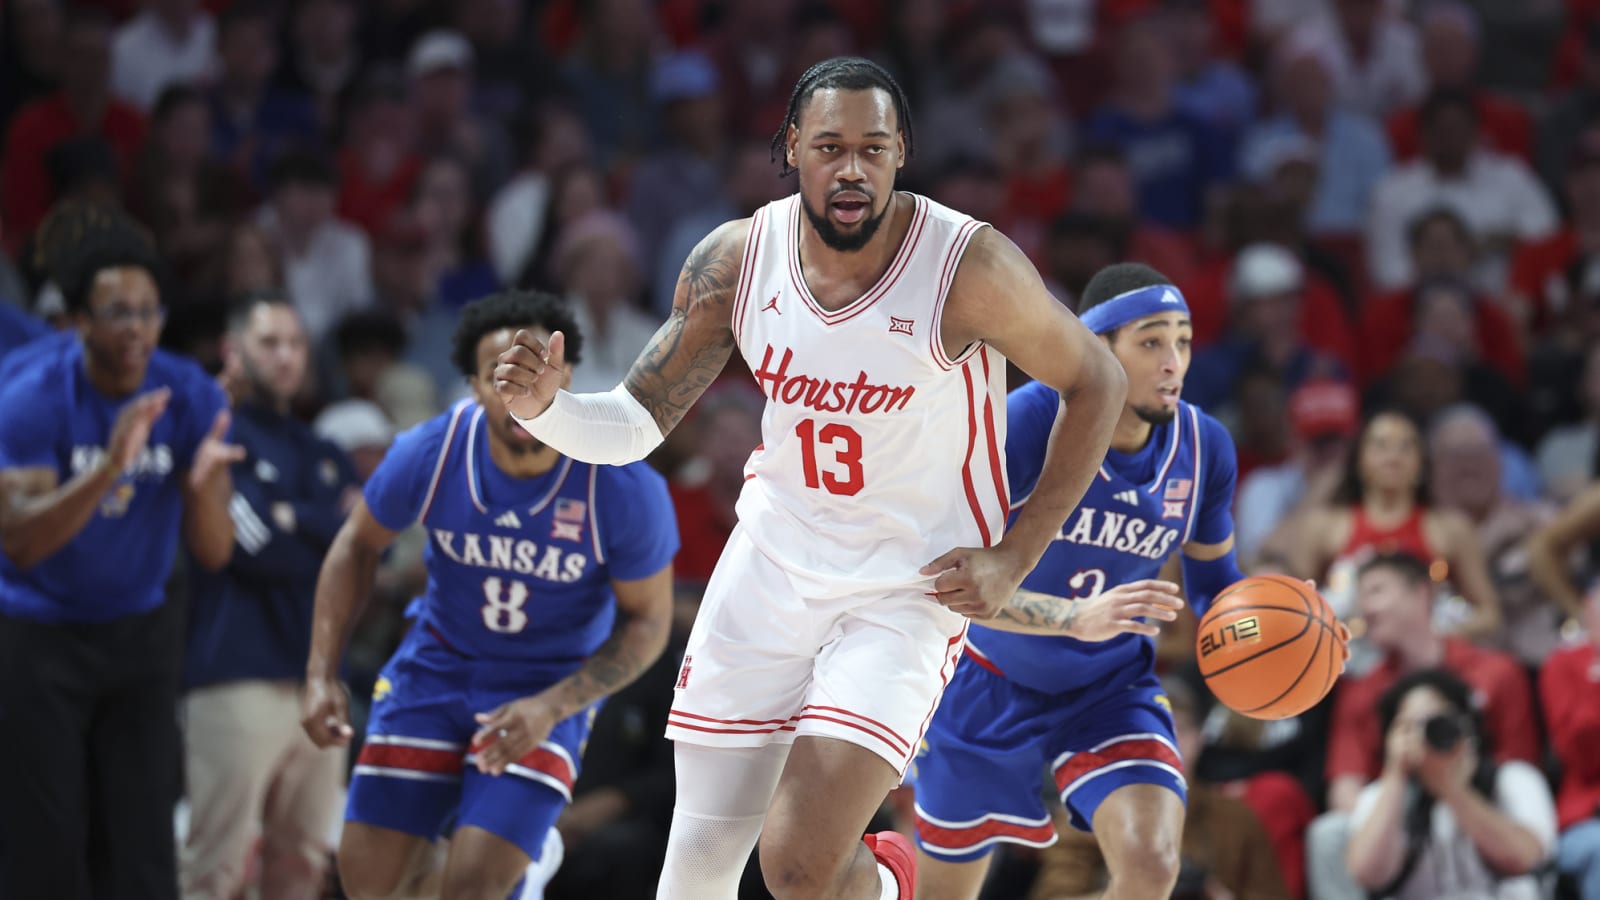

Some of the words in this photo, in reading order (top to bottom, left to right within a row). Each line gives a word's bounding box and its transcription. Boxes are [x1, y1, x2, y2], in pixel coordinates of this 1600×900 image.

[755, 343, 915, 414] Houston
[795, 418, 865, 496] 13
[1055, 507, 1179, 559] ANSAS
[482, 577, 529, 633] 8
[1200, 617, 1259, 658] ELITE
